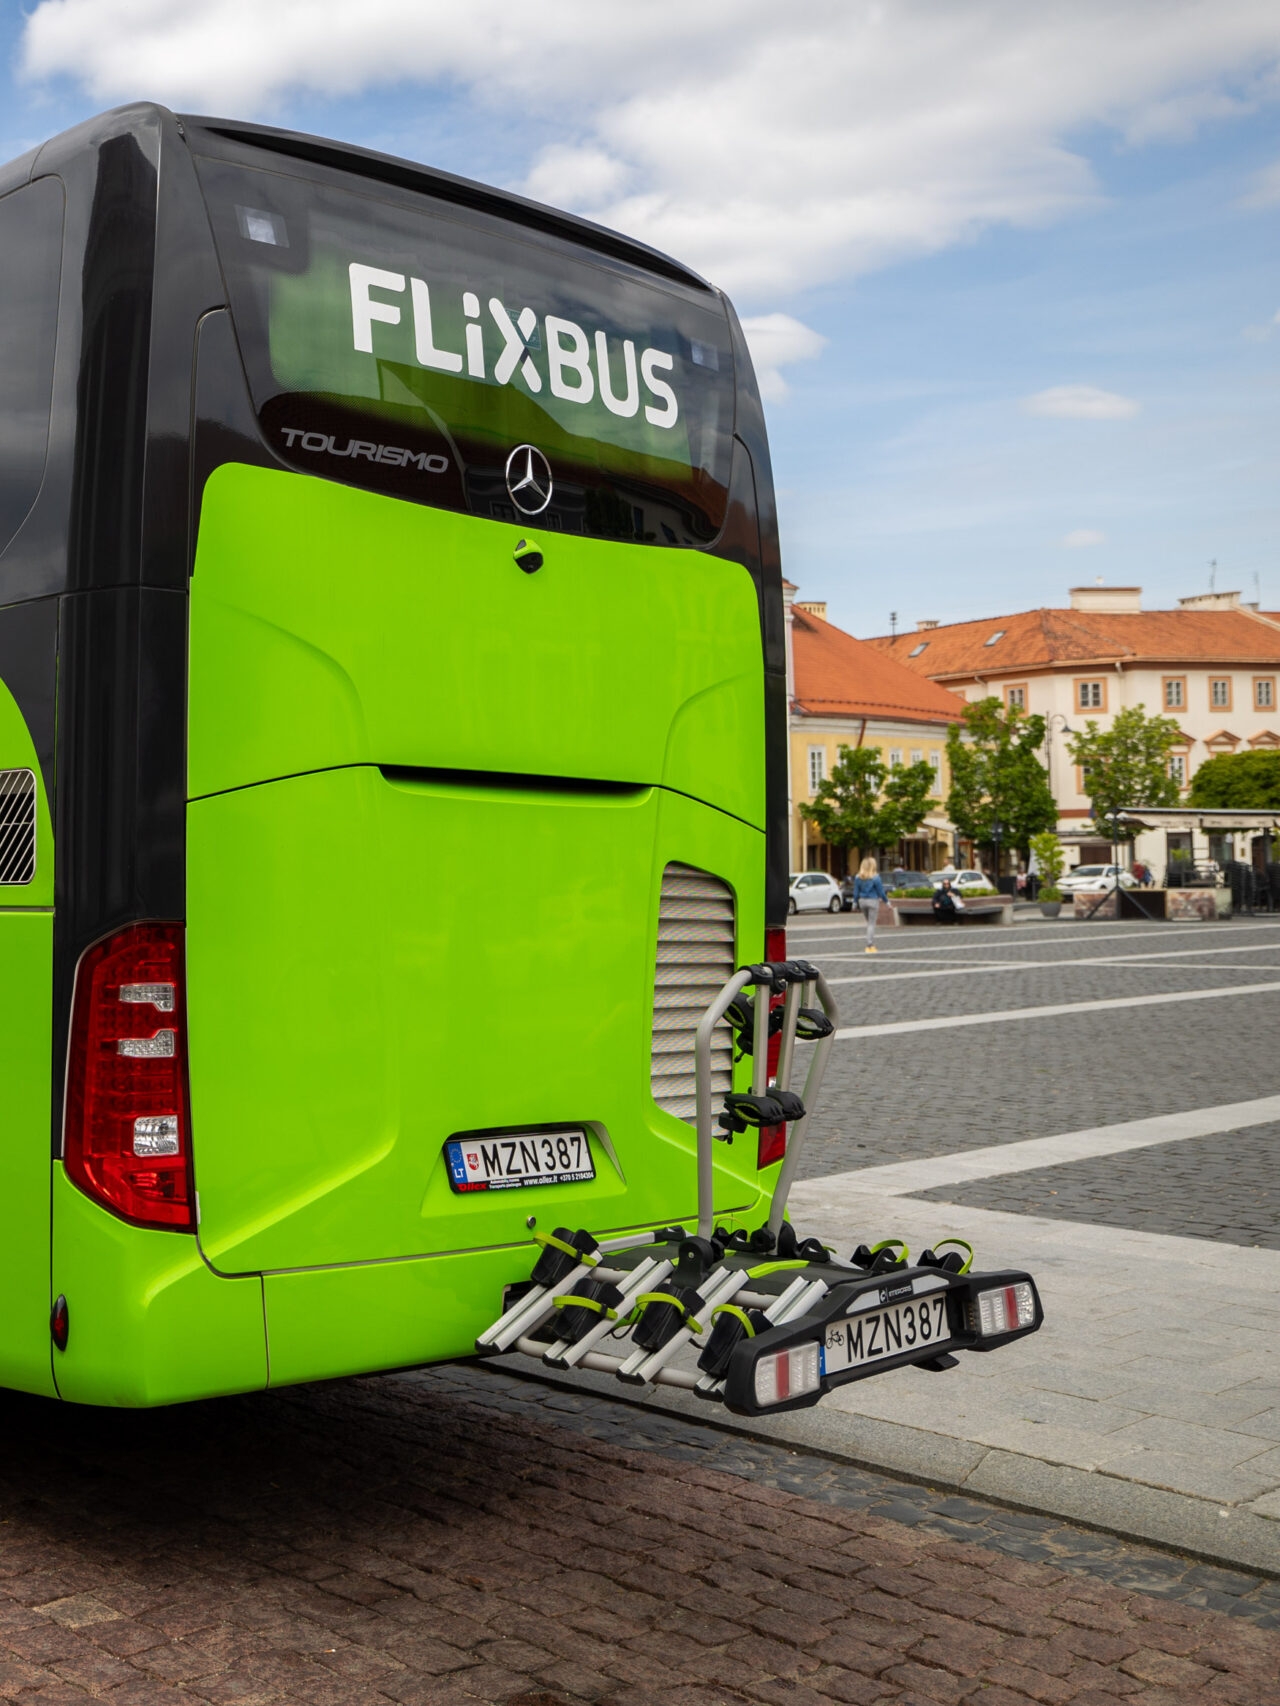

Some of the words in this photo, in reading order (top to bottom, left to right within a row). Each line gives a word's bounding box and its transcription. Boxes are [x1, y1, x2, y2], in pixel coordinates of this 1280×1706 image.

[280, 427, 449, 474] TOURISMO
[453, 1168, 464, 1179] LT
[845, 1299, 945, 1363] MZN387
